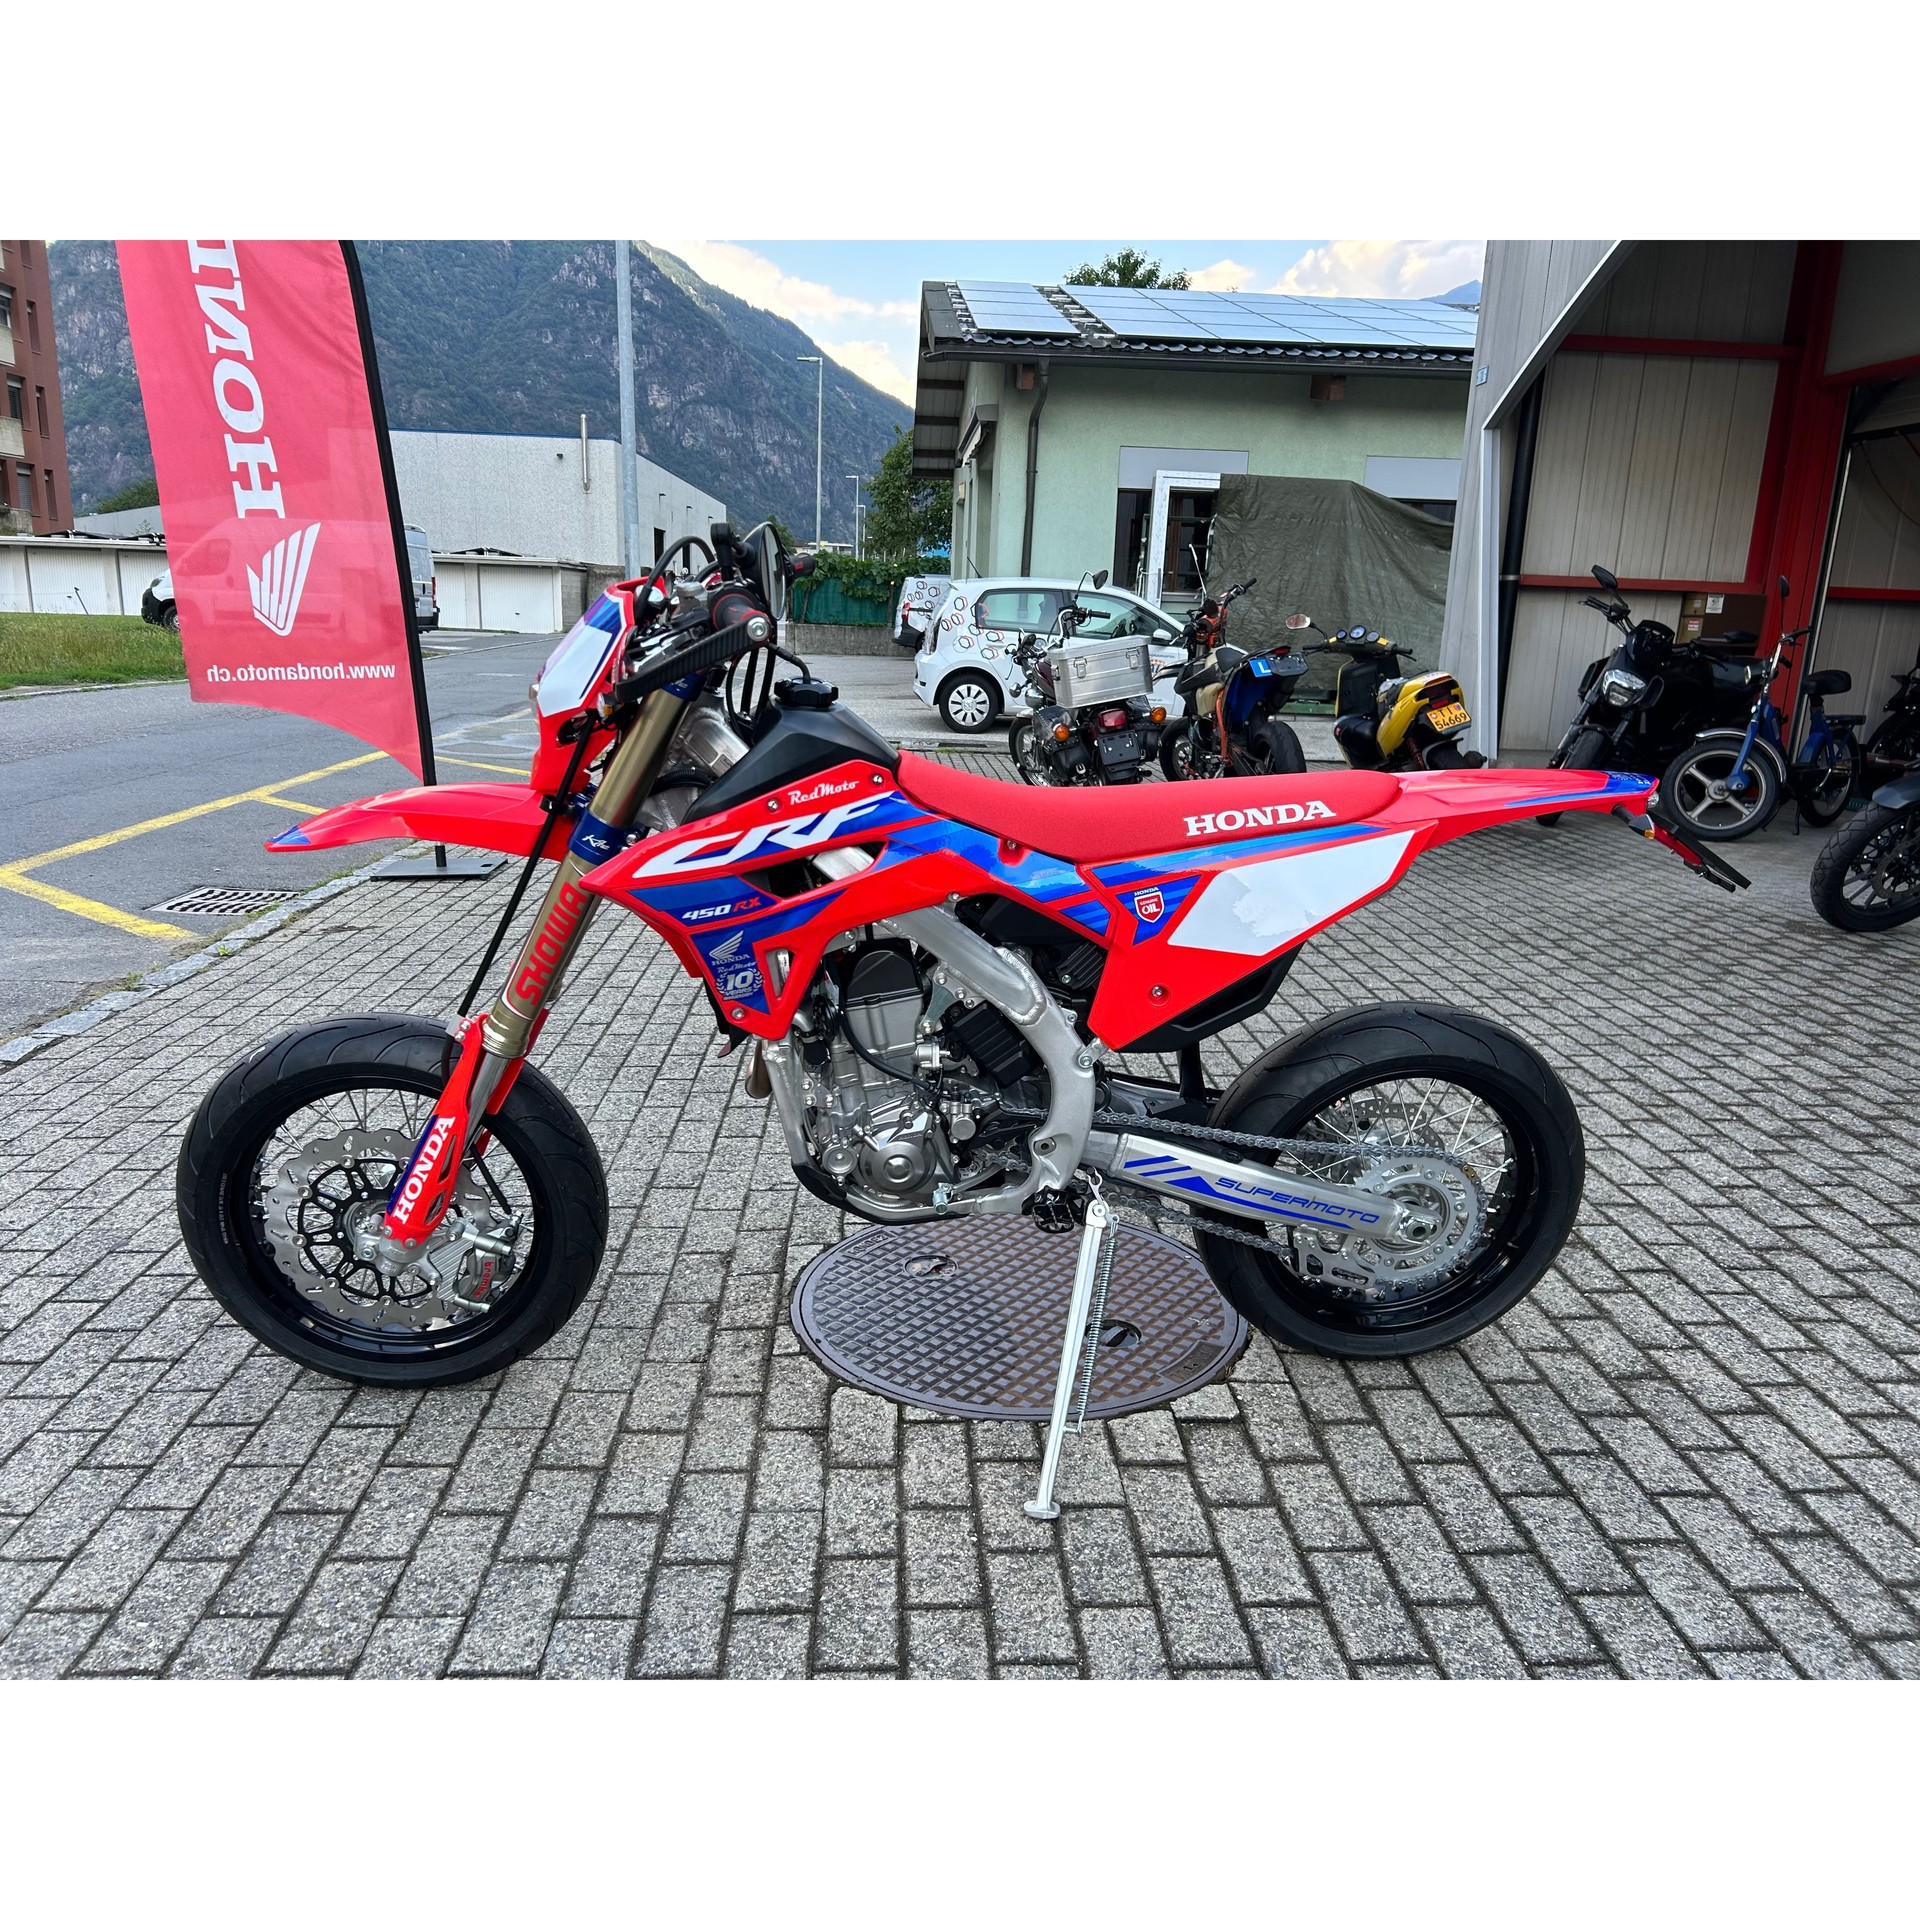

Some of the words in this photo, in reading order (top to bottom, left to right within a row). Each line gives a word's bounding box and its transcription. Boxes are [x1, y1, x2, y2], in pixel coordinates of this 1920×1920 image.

[1435, 713, 1467, 729] 54669
[1183, 800, 1337, 837] HONDA
[632, 790, 897, 879] CRF
[1134, 887, 1160, 896] HONDA
[682, 904, 731, 920] 450
[732, 897, 761, 912] RX
[1142, 903, 1160, 914] OIL
[515, 881, 588, 1007] SHOWA
[711, 954, 750, 966] HONDA
[726, 971, 754, 990] 10
[393, 1117, 456, 1225] HONDA
[1215, 1177, 1380, 1224] SUPERMOTO
